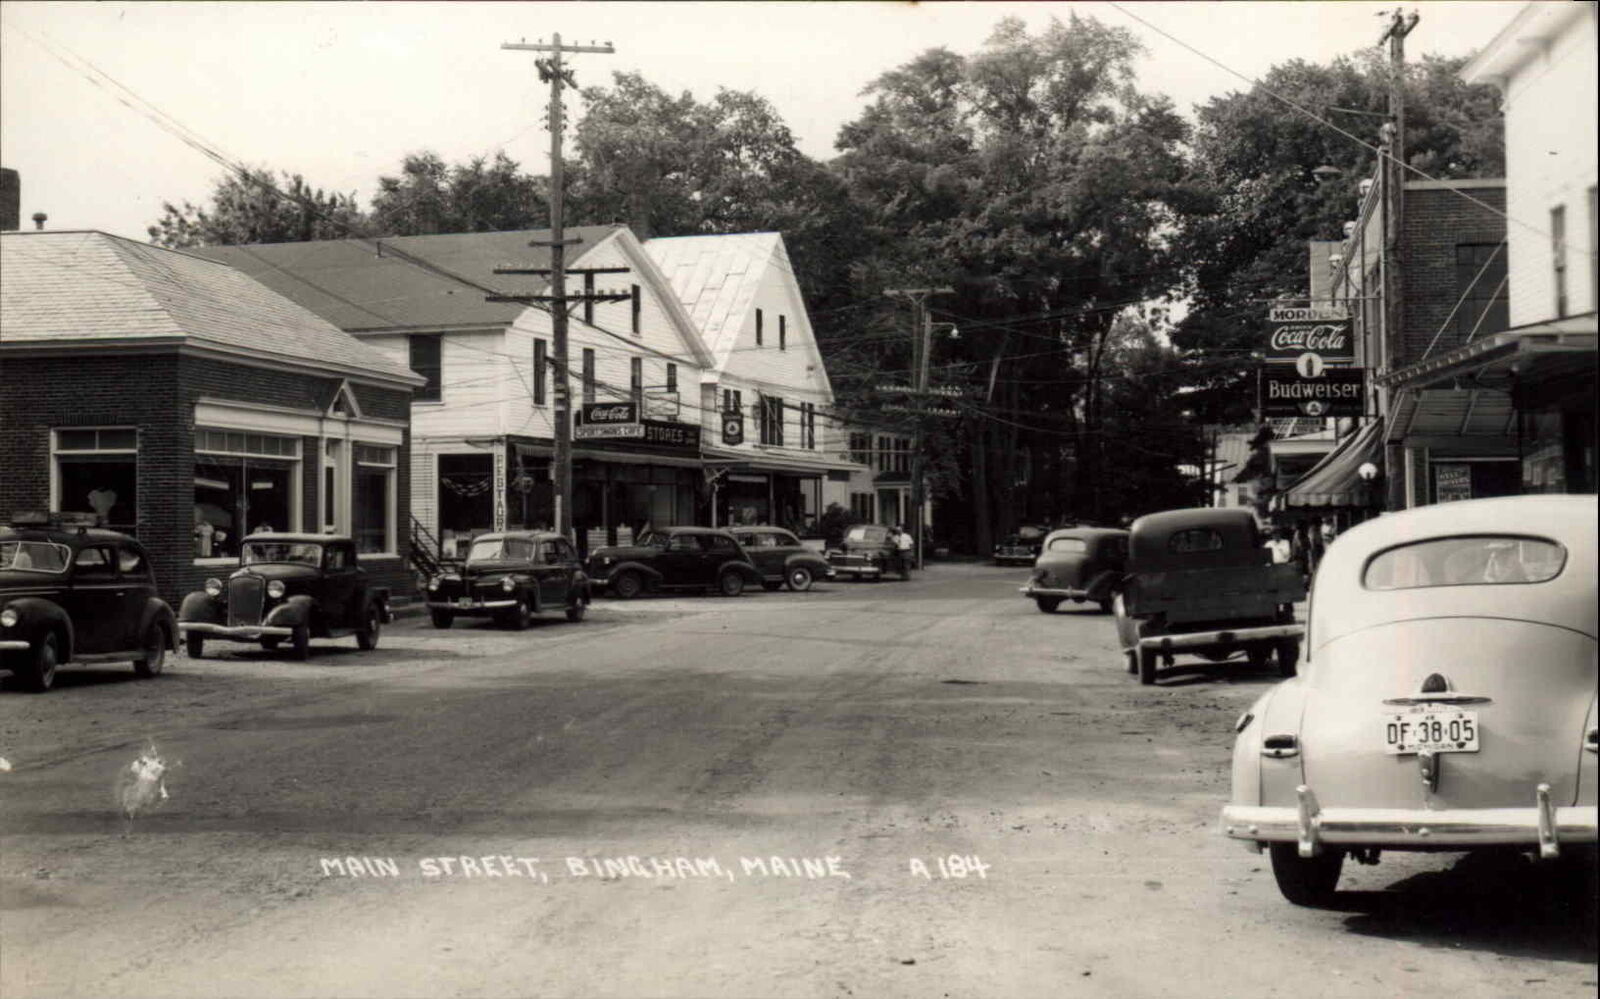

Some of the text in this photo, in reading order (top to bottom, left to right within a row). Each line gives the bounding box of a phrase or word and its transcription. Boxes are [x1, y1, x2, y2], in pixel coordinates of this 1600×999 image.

[1271, 324, 1348, 351] Coca-Cola
[1269, 380, 1361, 398] Budweiser
[590, 406, 630, 421] Coca-Cola
[646, 426, 683, 443] STORES
